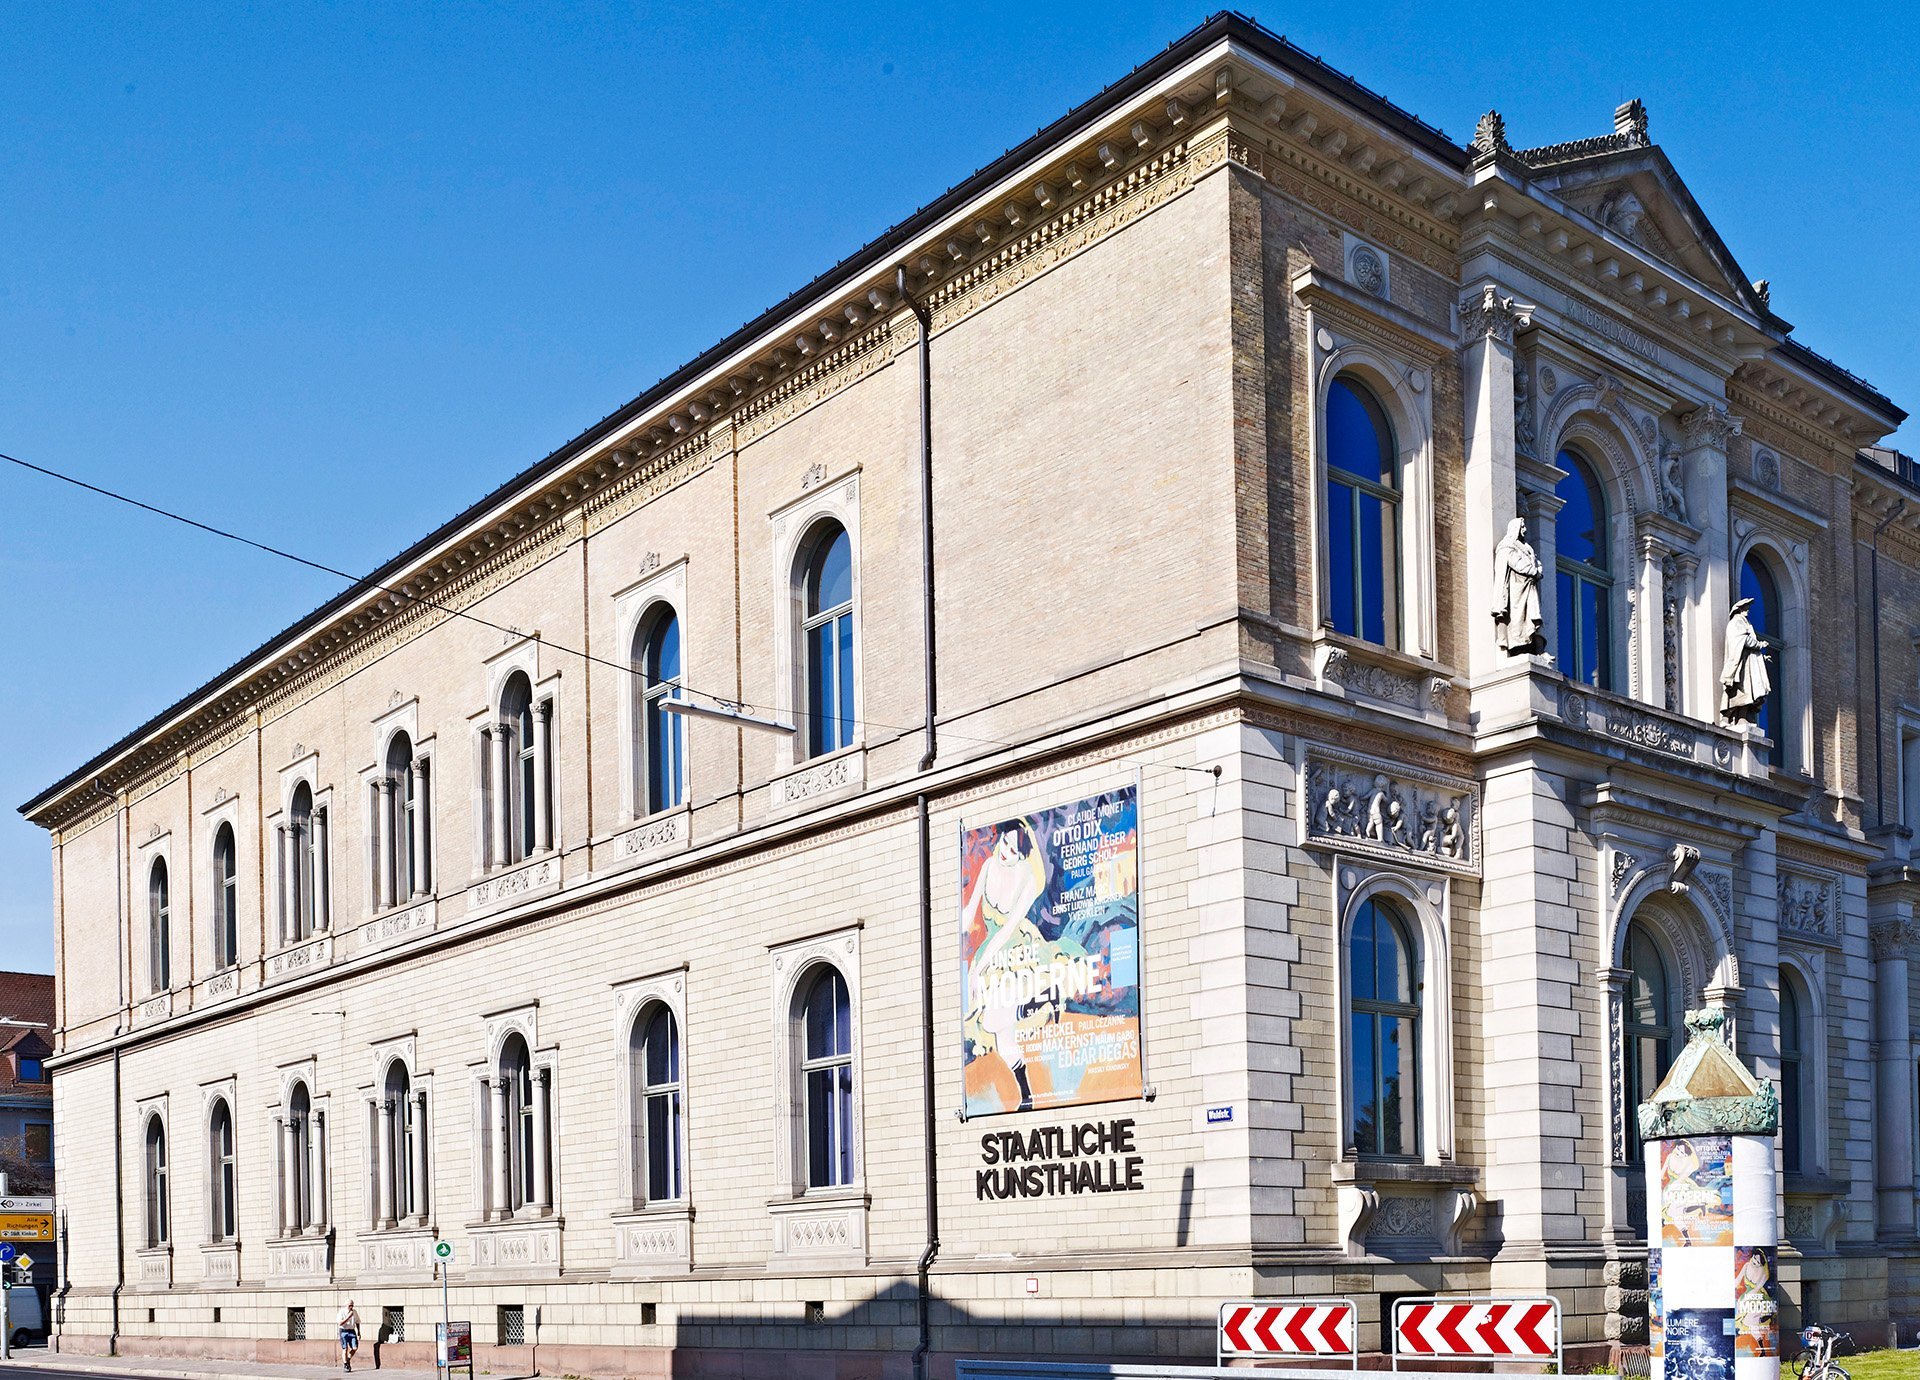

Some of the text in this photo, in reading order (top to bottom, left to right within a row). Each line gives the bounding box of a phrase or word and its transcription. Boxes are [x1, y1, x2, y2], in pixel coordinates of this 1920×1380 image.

[1053, 819, 1102, 846] OTTO DIX
[1061, 831, 1126, 858] FERNAND LÉGER
[1063, 855, 1087, 870] GEORG
[1060, 888, 1085, 903] FRANZ
[979, 953, 1103, 1011] MODERNE
[1014, 1026, 1041, 1043] ERICH
[1041, 1021, 1076, 1039] HECKEL
[1064, 1032, 1096, 1050] ERNST
[1058, 1040, 1138, 1069] EDGAR DEGAS
[981, 1118, 1135, 1165] STAATLICHE
[976, 1156, 1144, 1201] KUNSTHALLE
[1666, 1327, 1689, 1336] NOIRE
